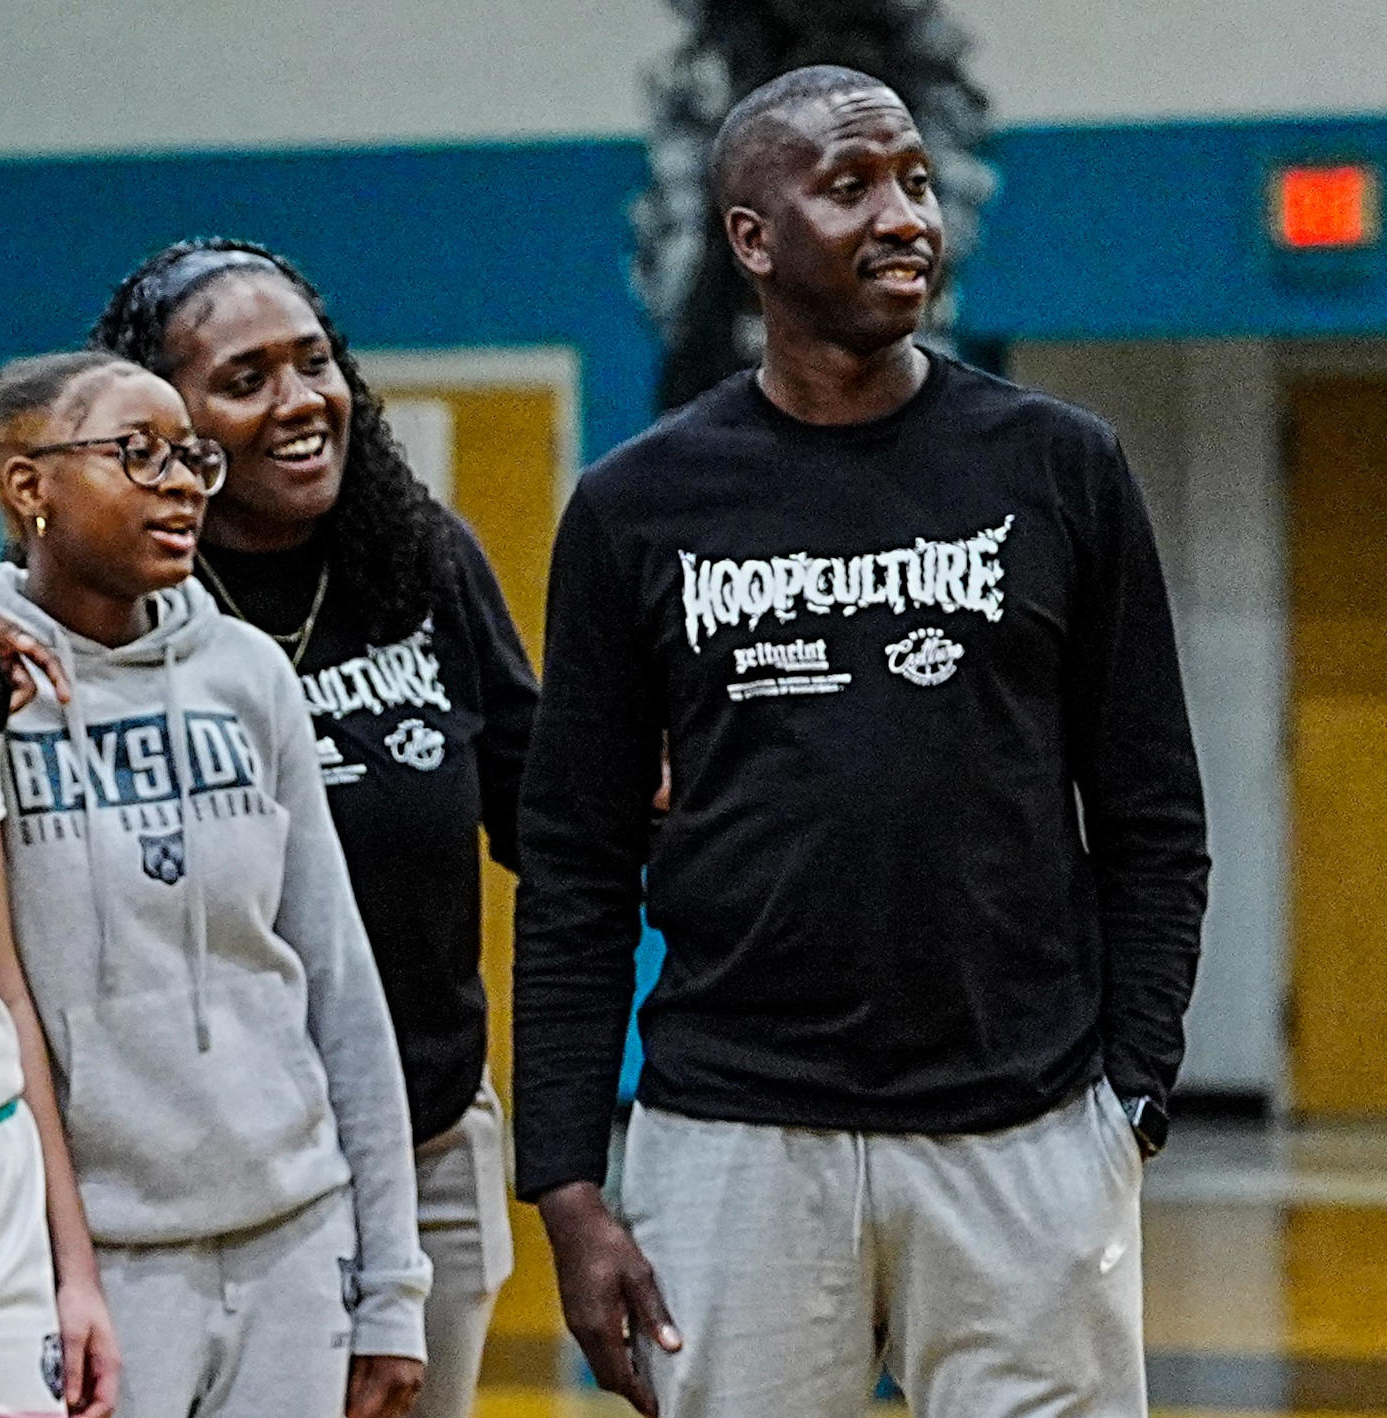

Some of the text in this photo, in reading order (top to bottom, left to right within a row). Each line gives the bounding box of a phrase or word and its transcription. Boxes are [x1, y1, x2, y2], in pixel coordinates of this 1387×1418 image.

[679, 514, 1014, 653] HOOPCULTURE
[301, 612, 452, 719] ULTURE
[10, 716, 263, 809] BAYSDE
